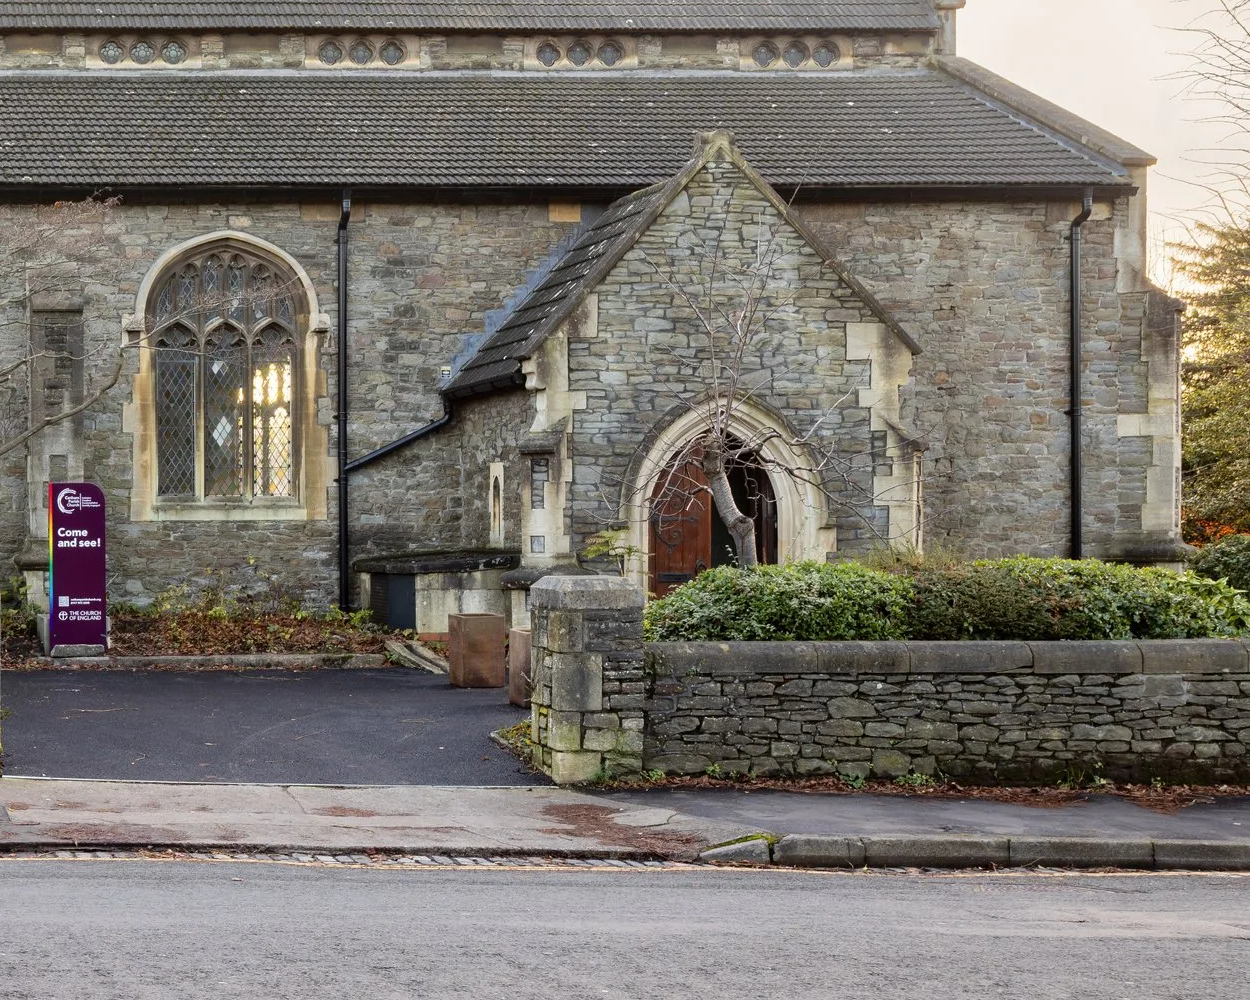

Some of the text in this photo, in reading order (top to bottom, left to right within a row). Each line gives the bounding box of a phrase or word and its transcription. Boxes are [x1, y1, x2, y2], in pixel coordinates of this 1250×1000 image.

[58, 528, 88, 536] Come
[58, 538, 101, 547] and see!
